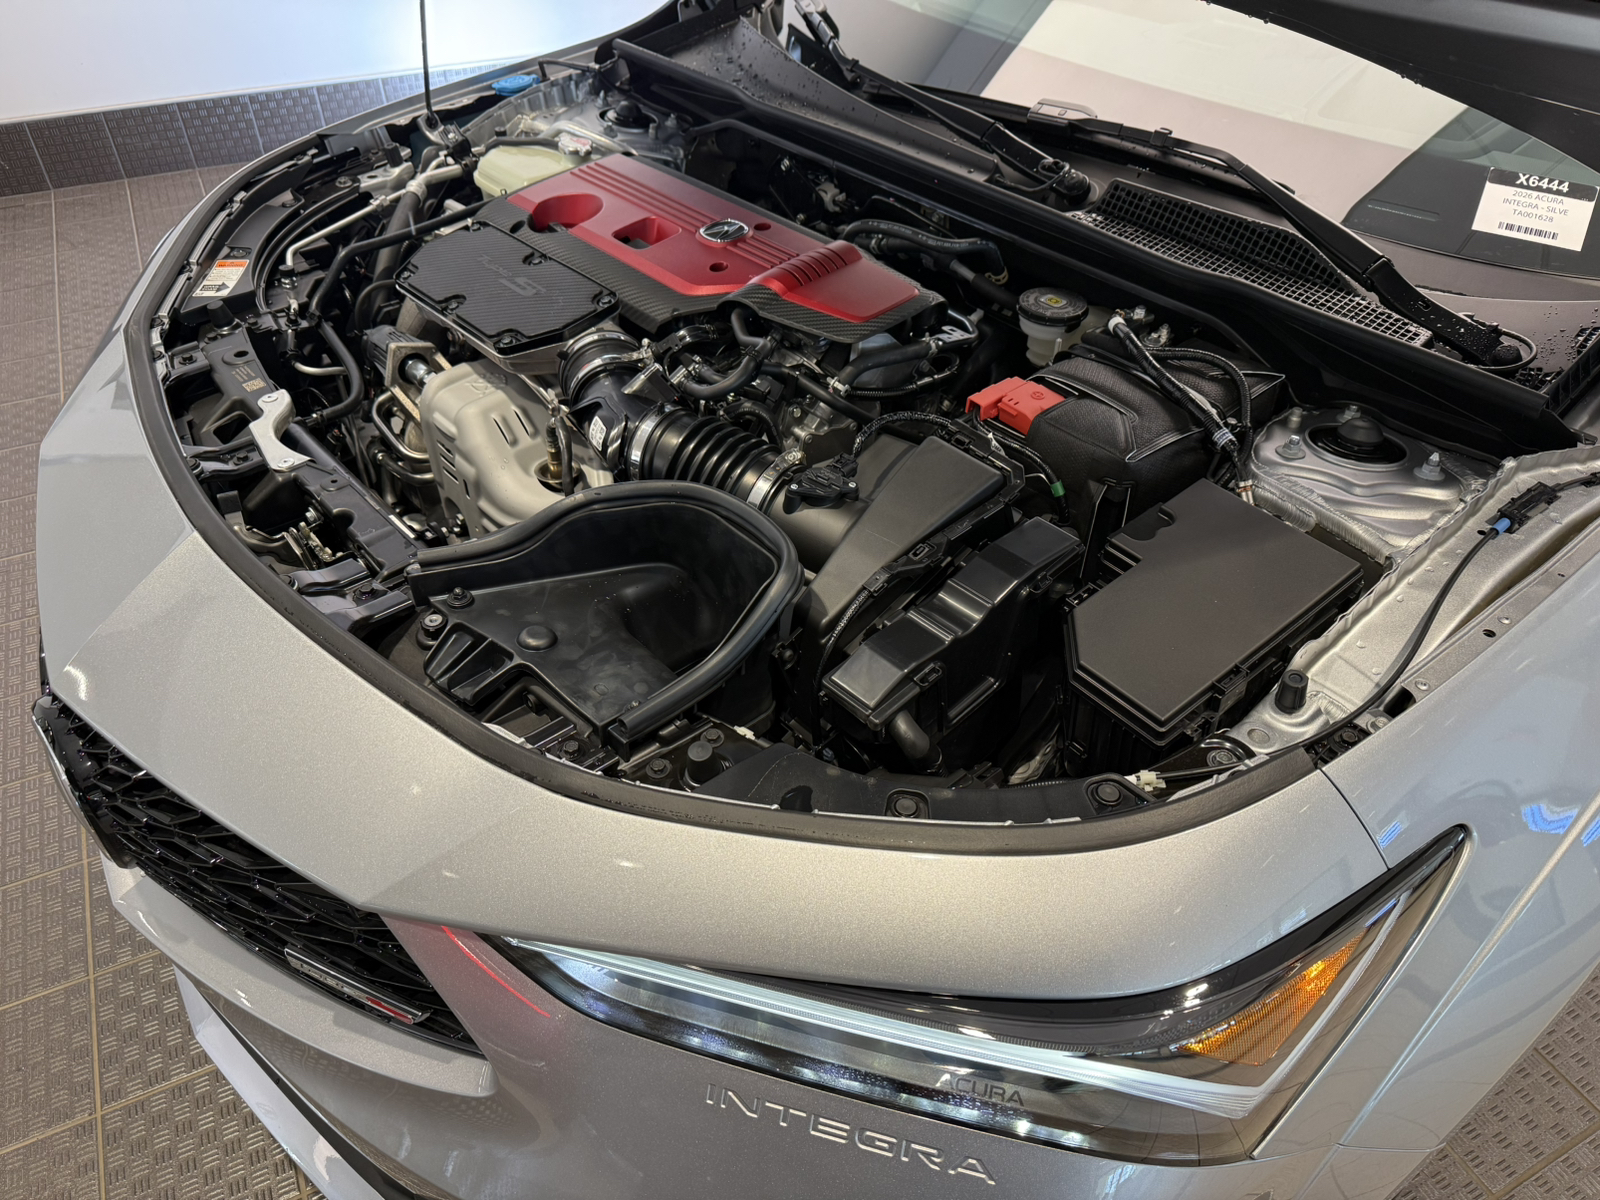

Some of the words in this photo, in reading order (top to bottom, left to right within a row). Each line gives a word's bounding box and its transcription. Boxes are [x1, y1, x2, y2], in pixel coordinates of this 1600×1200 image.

[1515, 172, 1570, 193] X6444
[1502, 198, 1539, 210] INTEGRA
[1546, 206, 1569, 216] SILVE
[1512, 190, 1533, 199] 2026
[1534, 194, 1564, 205] ACURA
[1512, 209, 1554, 223] TA001628
[935, 1073, 1025, 1107] ACURA
[706, 1083, 996, 1185] INTEGRA
